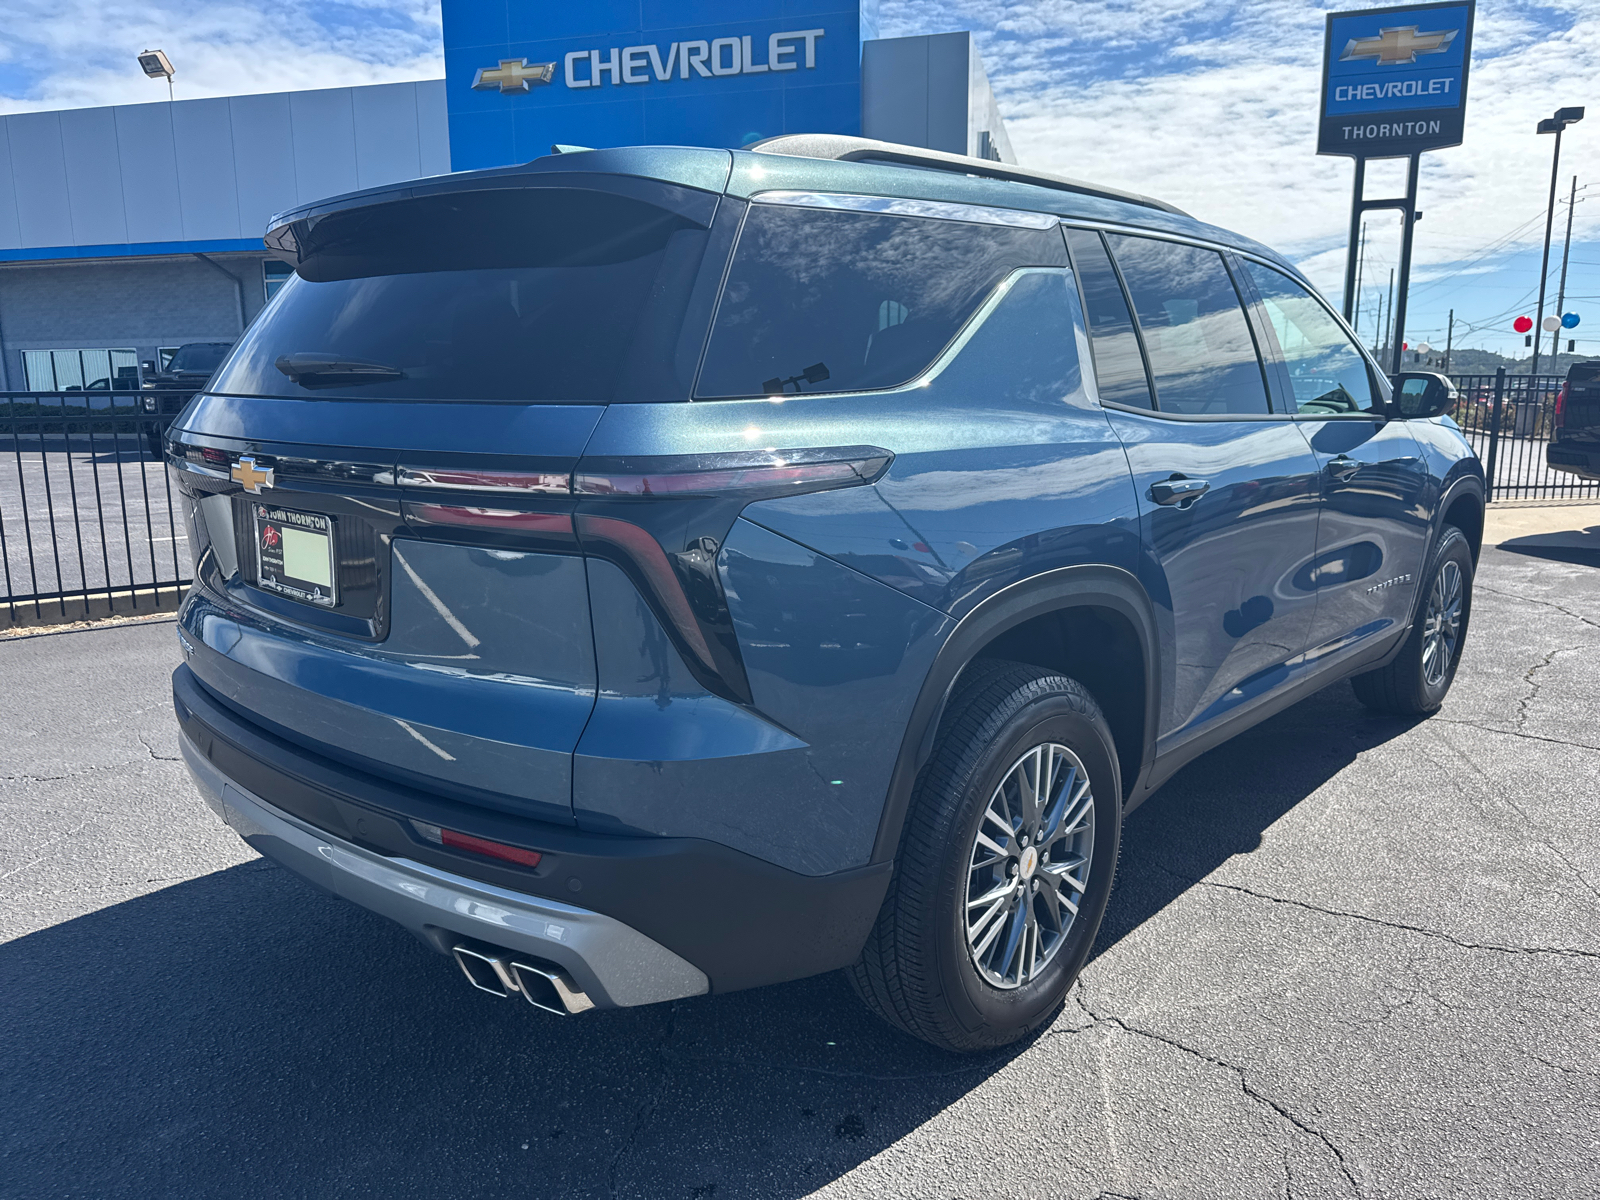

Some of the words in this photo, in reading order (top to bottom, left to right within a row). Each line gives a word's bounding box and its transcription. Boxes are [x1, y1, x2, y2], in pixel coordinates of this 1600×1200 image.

[564, 28, 825, 89] CHEVROLET
[1335, 78, 1454, 101] CHEVROLET
[1342, 120, 1441, 140] THORNTON
[269, 510, 287, 522] JOHN
[286, 512, 326, 530] THORNTON
[283, 586, 306, 598] CHEVROLET
